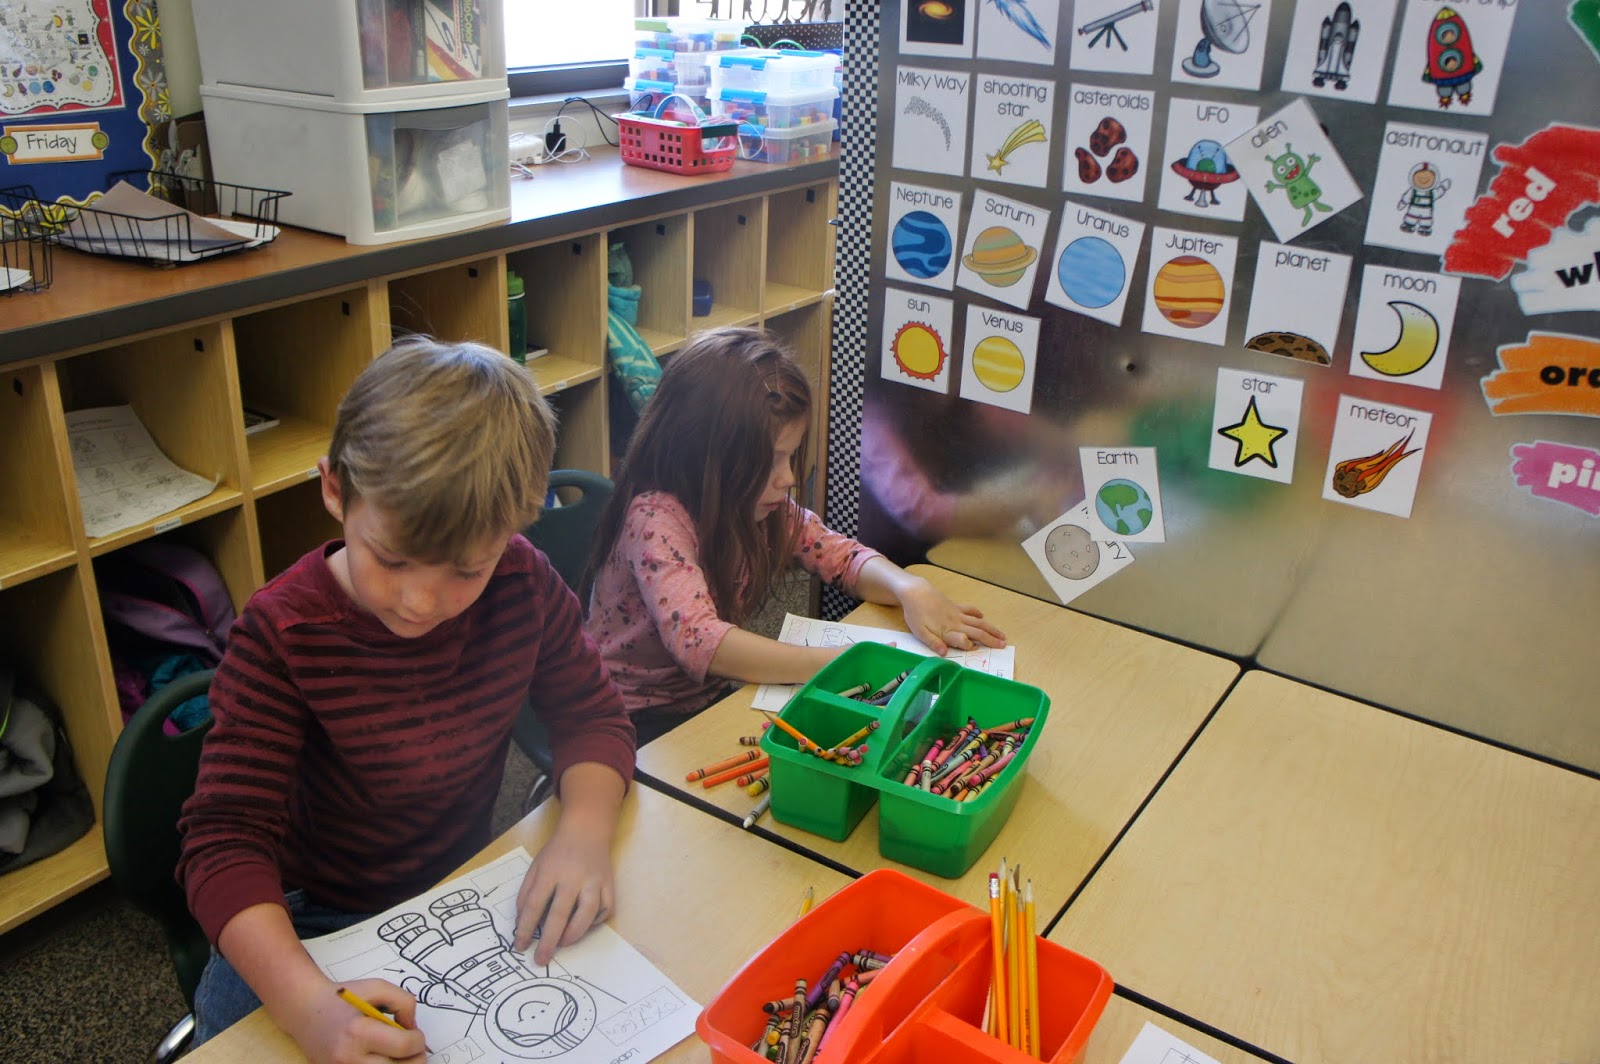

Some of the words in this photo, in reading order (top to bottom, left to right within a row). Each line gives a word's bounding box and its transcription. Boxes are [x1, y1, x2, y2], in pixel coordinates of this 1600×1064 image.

[899, 70, 931, 92] Milky
[934, 74, 968, 94] Way
[983, 79, 1048, 102] shooting
[997, 101, 1029, 118] star
[1073, 89, 1150, 111] asteroids
[1196, 105, 1230, 124] UFO
[26, 133, 78, 154] Friday
[1250, 119, 1289, 149] alien
[1385, 127, 1485, 157] astronaut
[896, 186, 954, 209] Neptune
[1491, 166, 1557, 239] red
[984, 197, 1035, 227] Saturn
[1076, 209, 1130, 238] Uranus
[1165, 233, 1224, 256] Jupiter
[1275, 249, 1331, 272] planet
[1383, 273, 1437, 295] moon
[907, 298, 931, 314] sun
[981, 311, 1024, 333] Venus
[1242, 375, 1278, 395] star
[1350, 403, 1418, 429] meteor
[1097, 451, 1139, 465] Earth
